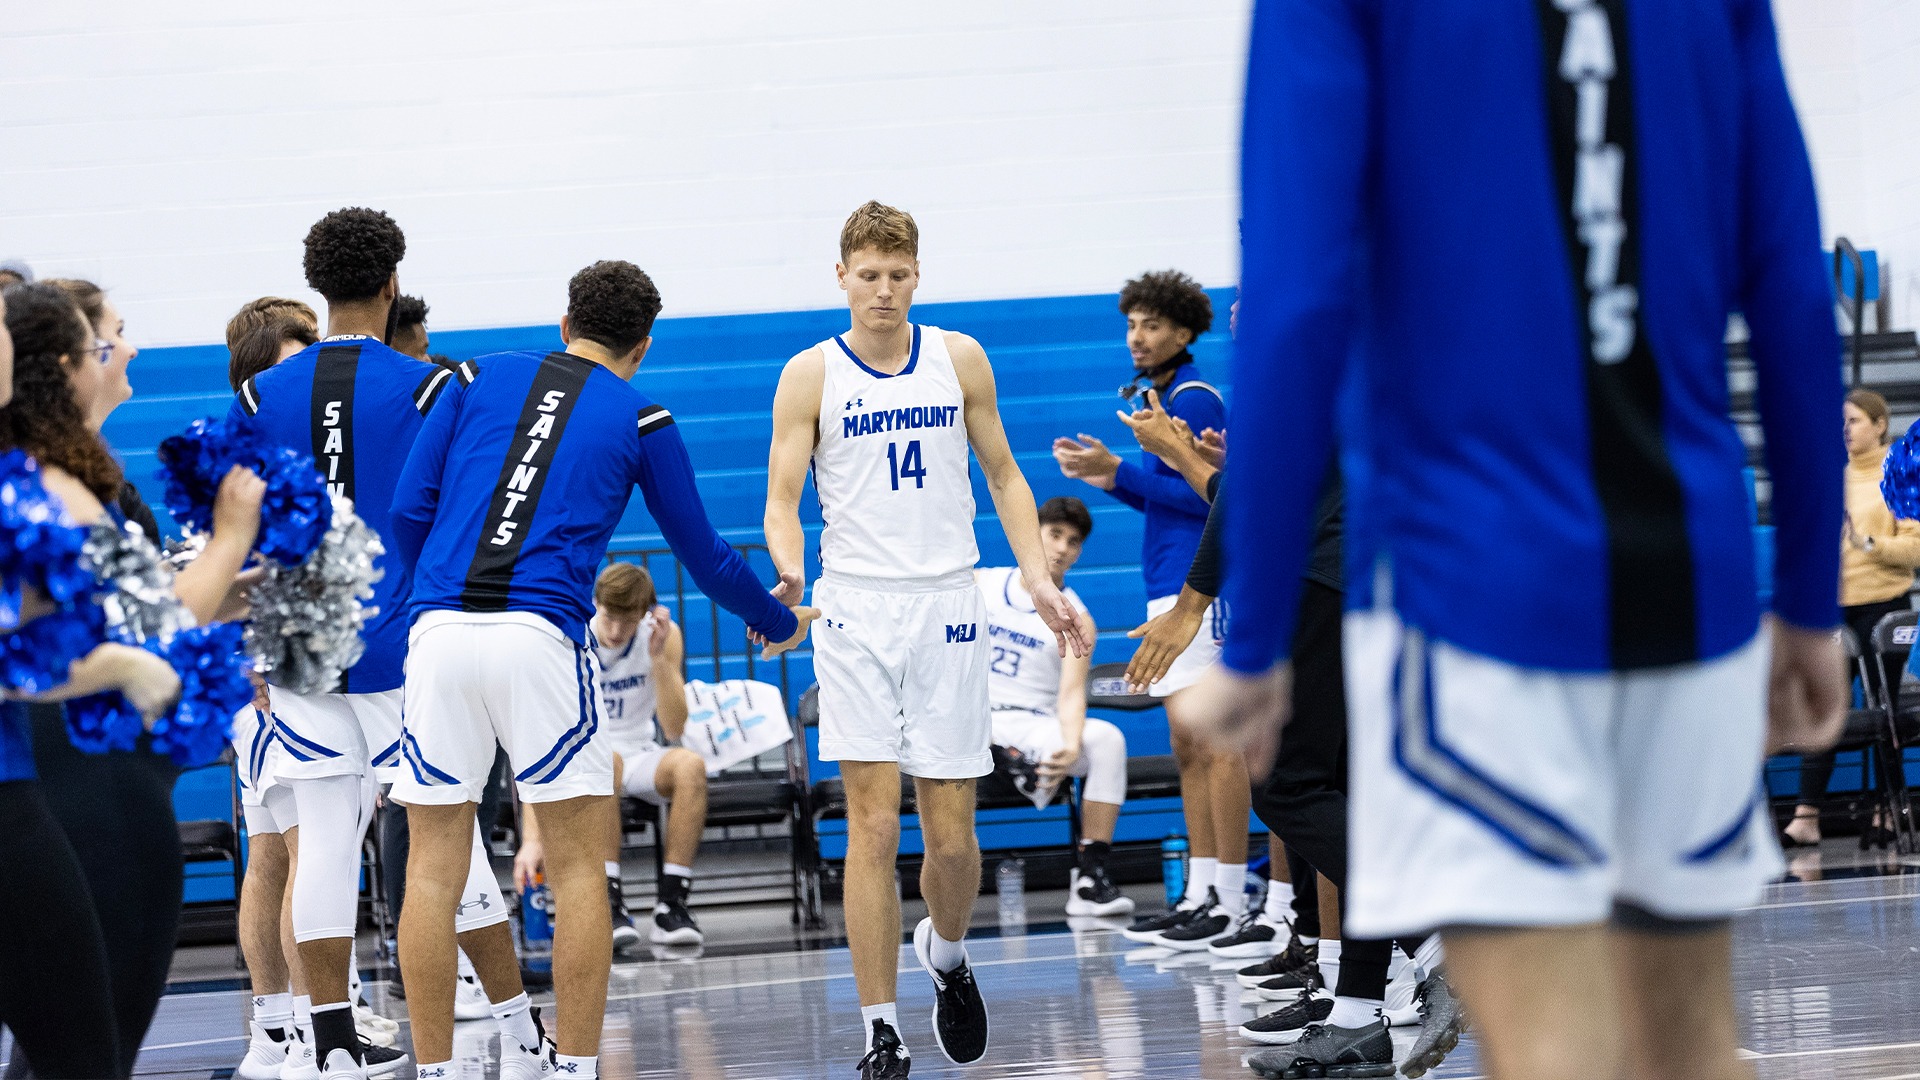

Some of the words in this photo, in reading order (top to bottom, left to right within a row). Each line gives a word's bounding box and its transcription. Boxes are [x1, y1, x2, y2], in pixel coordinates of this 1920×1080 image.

[842, 405, 959, 439] MARYMOUNT
[322, 401, 345, 500] SAIN
[886, 440, 927, 491] 14
[490, 390, 566, 546] SAINTS
[945, 623, 977, 643] MU
[991, 646, 1021, 677] 23
[603, 698, 624, 719] 21
